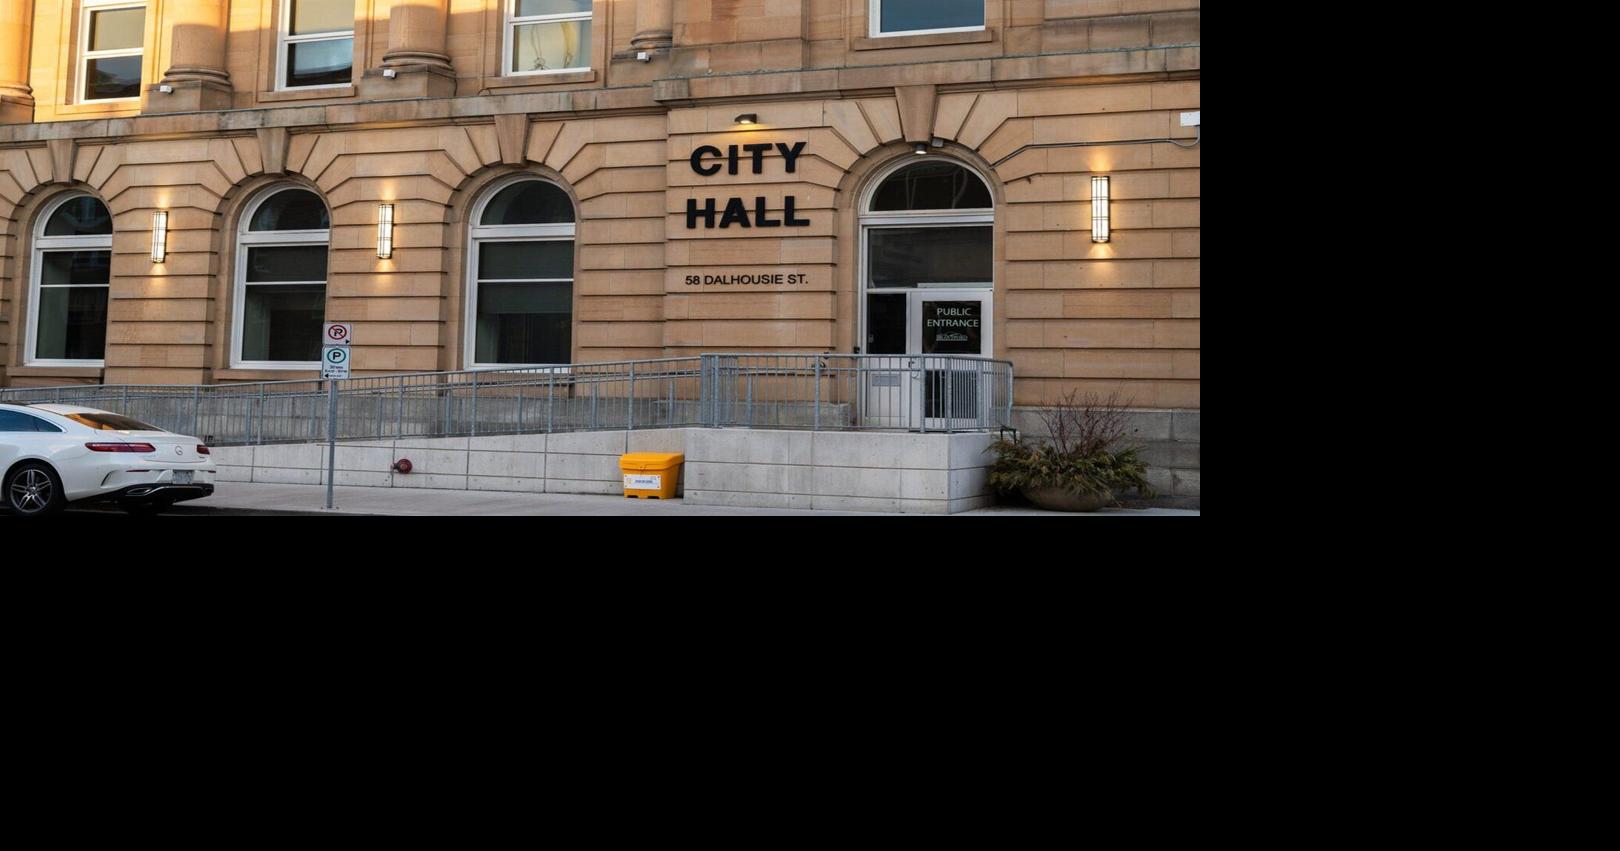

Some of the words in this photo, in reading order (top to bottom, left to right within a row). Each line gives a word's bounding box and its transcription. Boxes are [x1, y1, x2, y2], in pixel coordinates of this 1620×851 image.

[690, 142, 807, 176] CITY
[686, 196, 810, 229] HALL
[685, 275, 700, 285] 58
[704, 274, 783, 285] DALHOUSIE
[787, 274, 809, 284] ST.
[936, 307, 972, 316] PUBLIC
[927, 319, 979, 327] ENTRANCE
[333, 352, 341, 360] P
